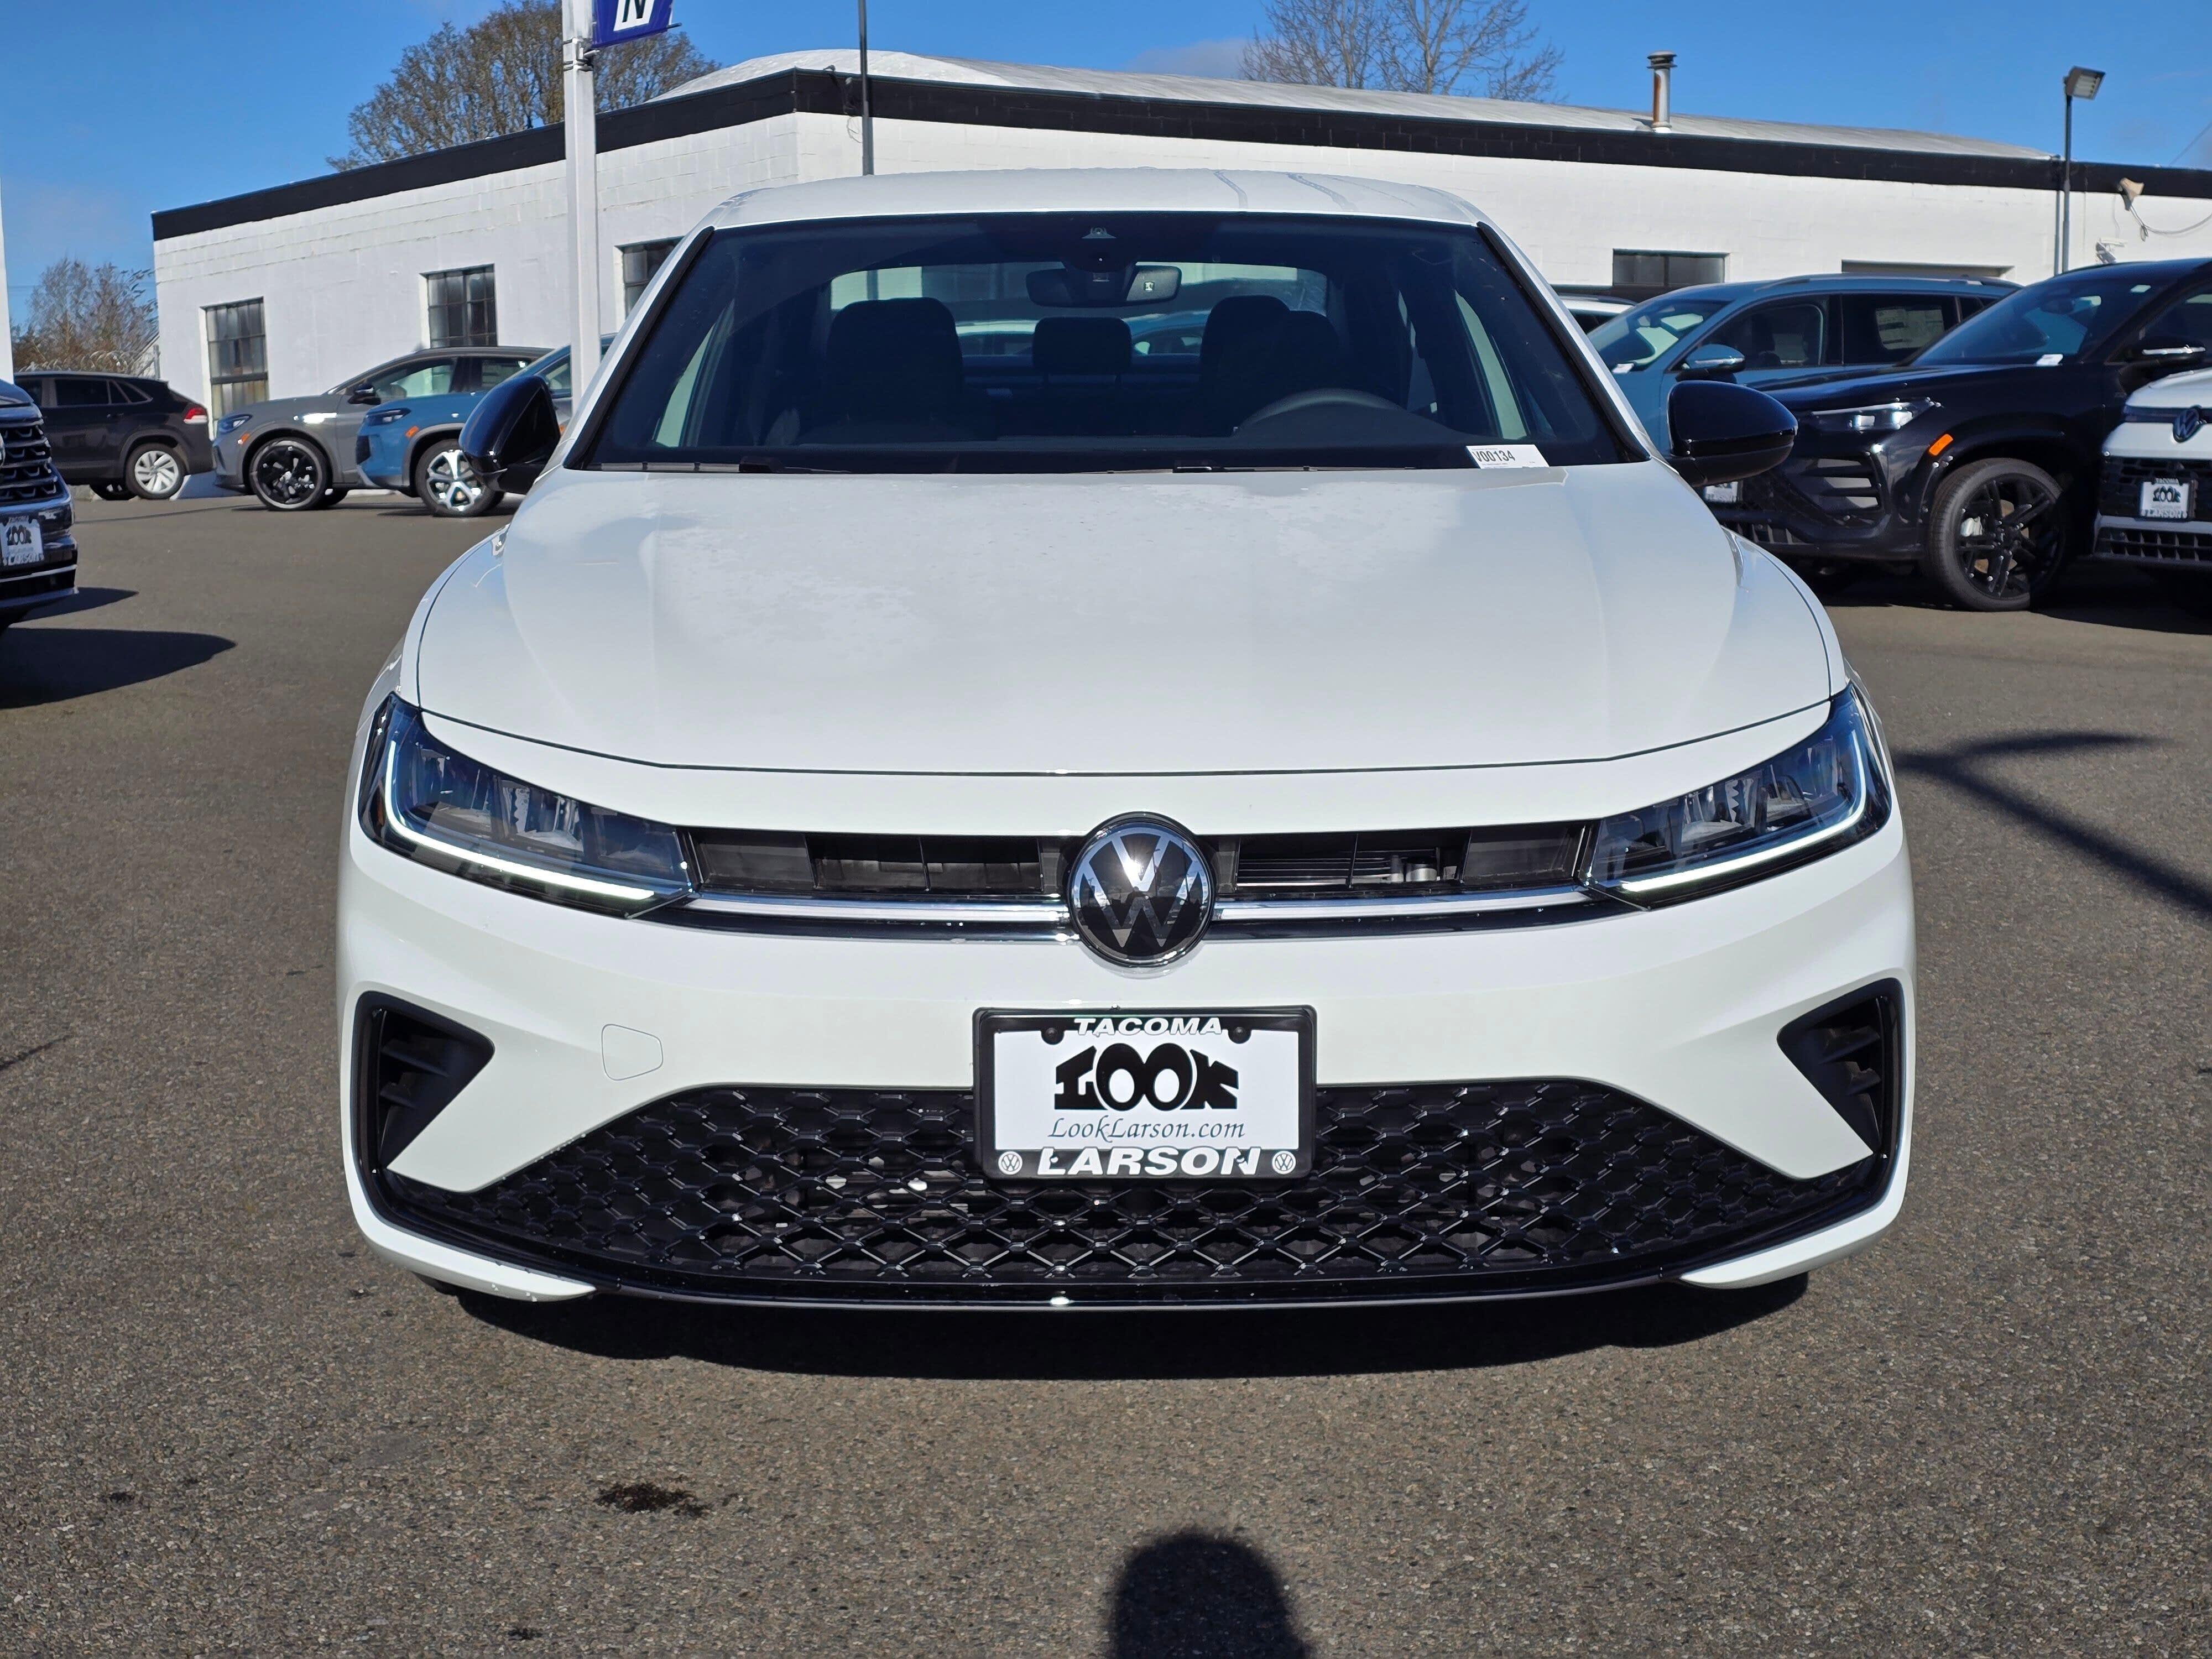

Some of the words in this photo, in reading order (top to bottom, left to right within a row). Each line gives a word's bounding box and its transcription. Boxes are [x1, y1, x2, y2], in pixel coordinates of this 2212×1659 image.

[1472, 450, 1515, 462] V00134
[1074, 1018, 1222, 1036] TACOMA
[1054, 1043, 1239, 1111] LOOK
[1048, 1115, 1246, 1143] LookLarson.com
[1037, 1147, 1261, 1176] LARSON
